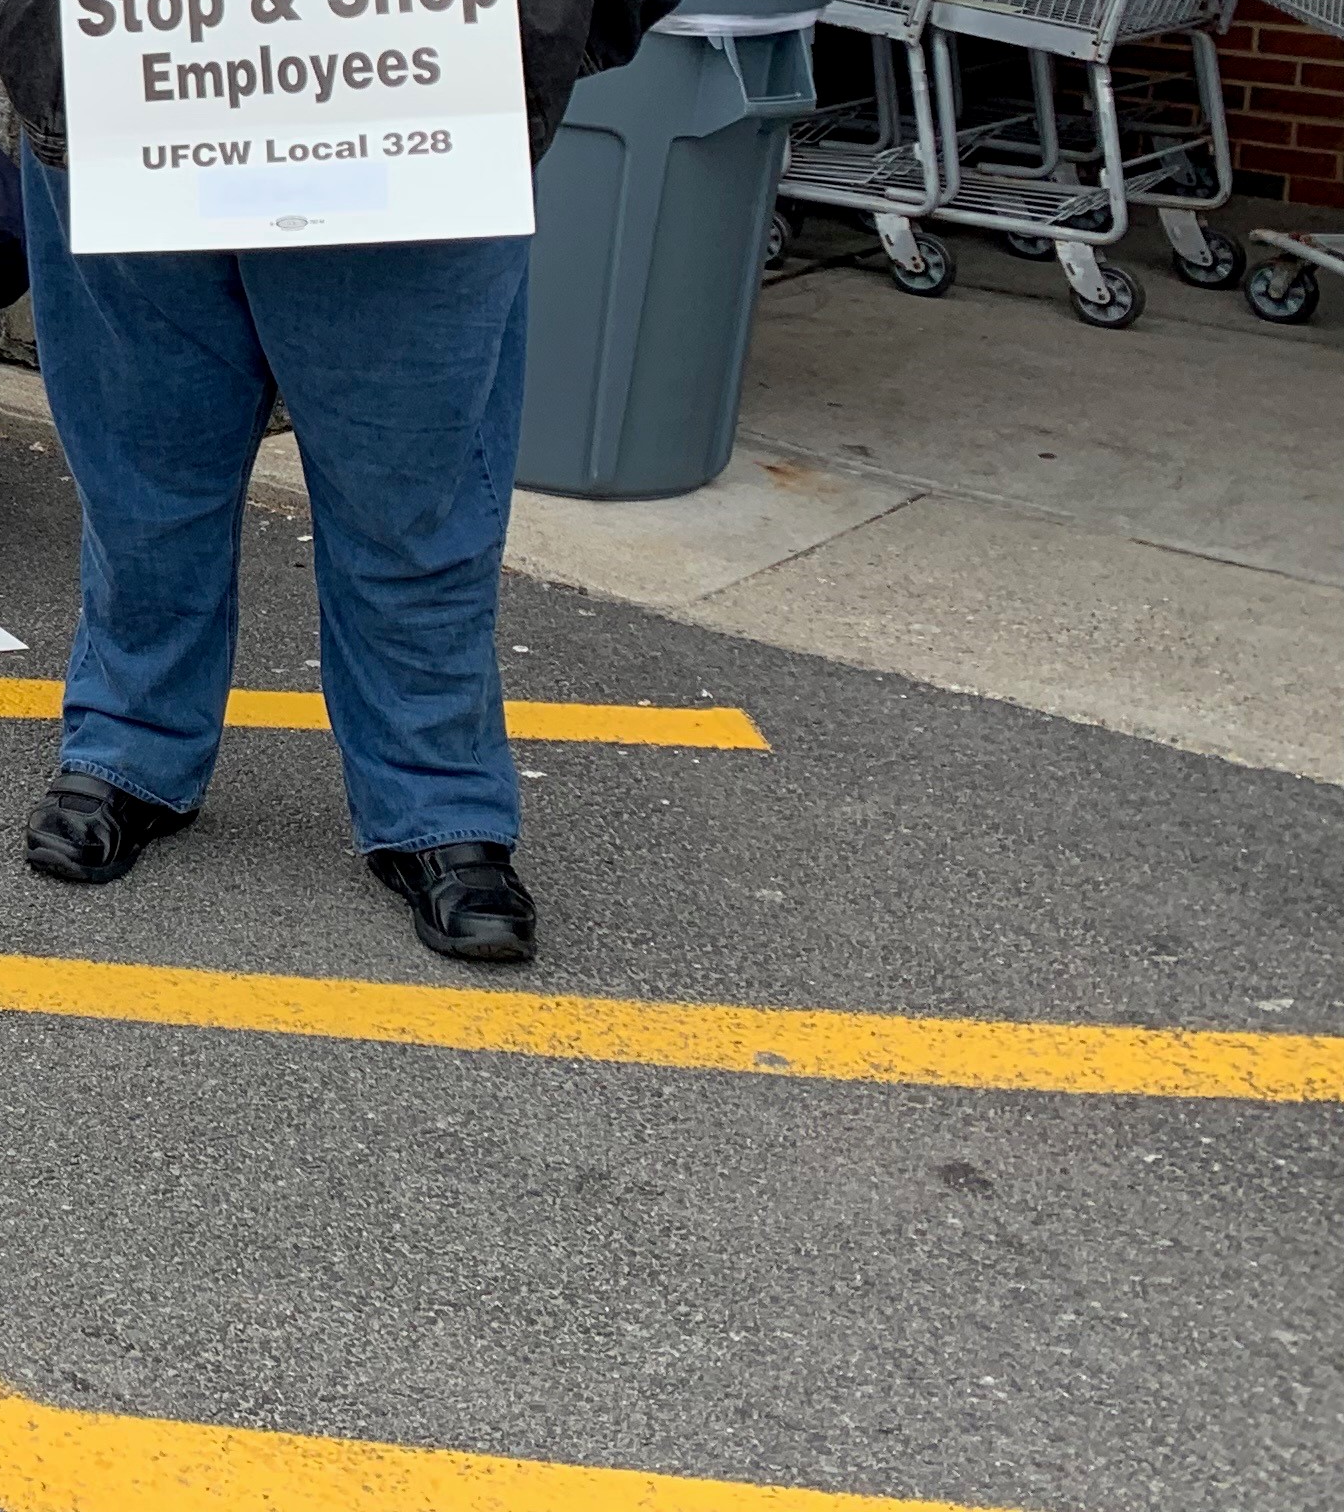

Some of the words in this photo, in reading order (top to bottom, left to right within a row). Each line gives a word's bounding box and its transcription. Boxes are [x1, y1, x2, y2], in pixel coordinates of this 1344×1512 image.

[141, 44, 442, 109] Employees
[142, 139, 252, 170] UFCW
[266, 134, 368, 163] Local
[382, 129, 453, 157] 328
